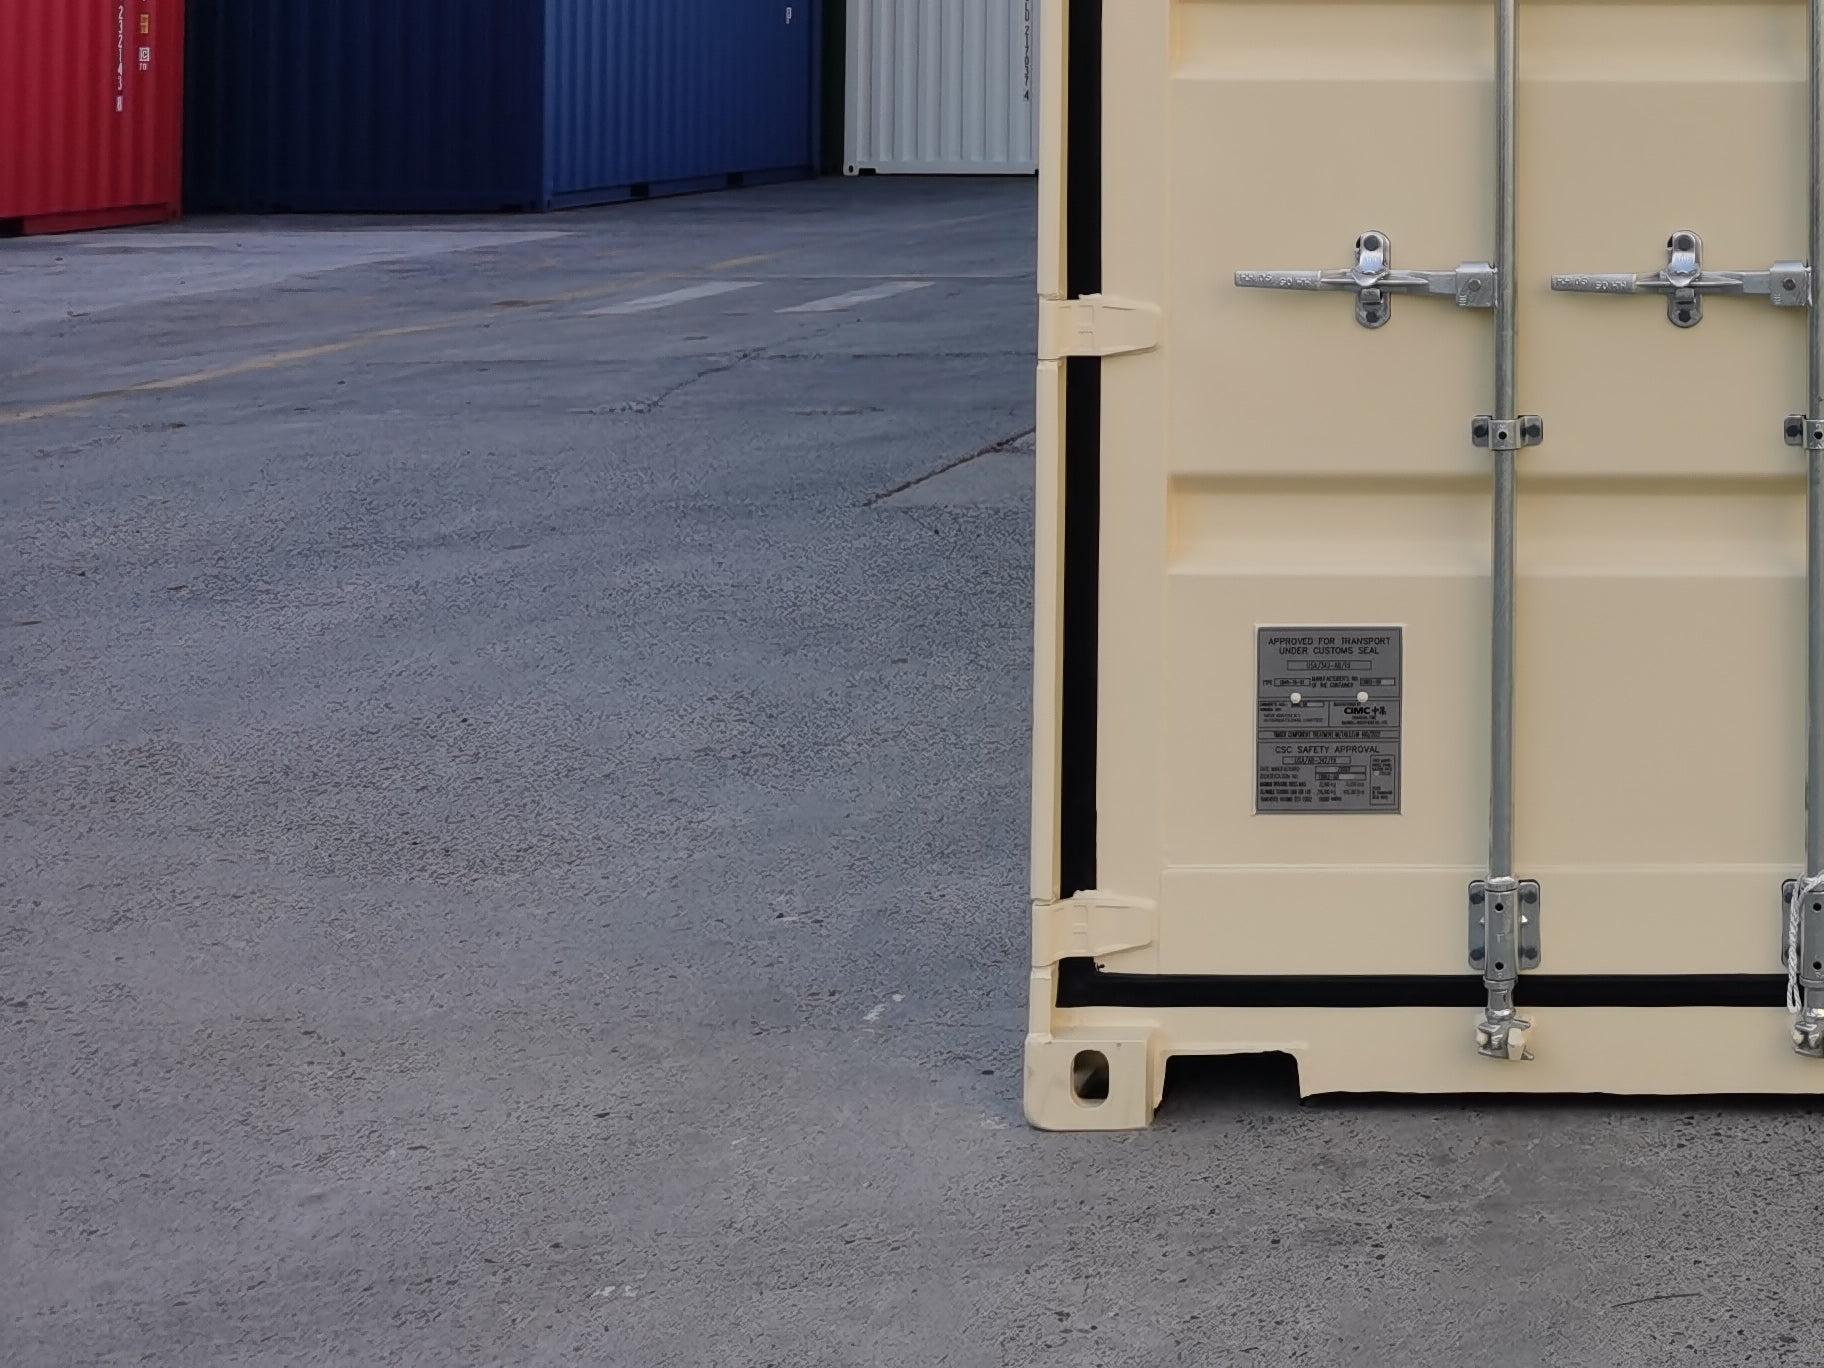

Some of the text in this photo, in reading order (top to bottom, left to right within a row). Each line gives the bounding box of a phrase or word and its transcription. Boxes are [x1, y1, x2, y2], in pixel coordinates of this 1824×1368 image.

[1268, 637, 1391, 645] APPROVED FOR TRANSPORT
[1279, 646, 1379, 654] UNDER CUSTOMS SEAL
